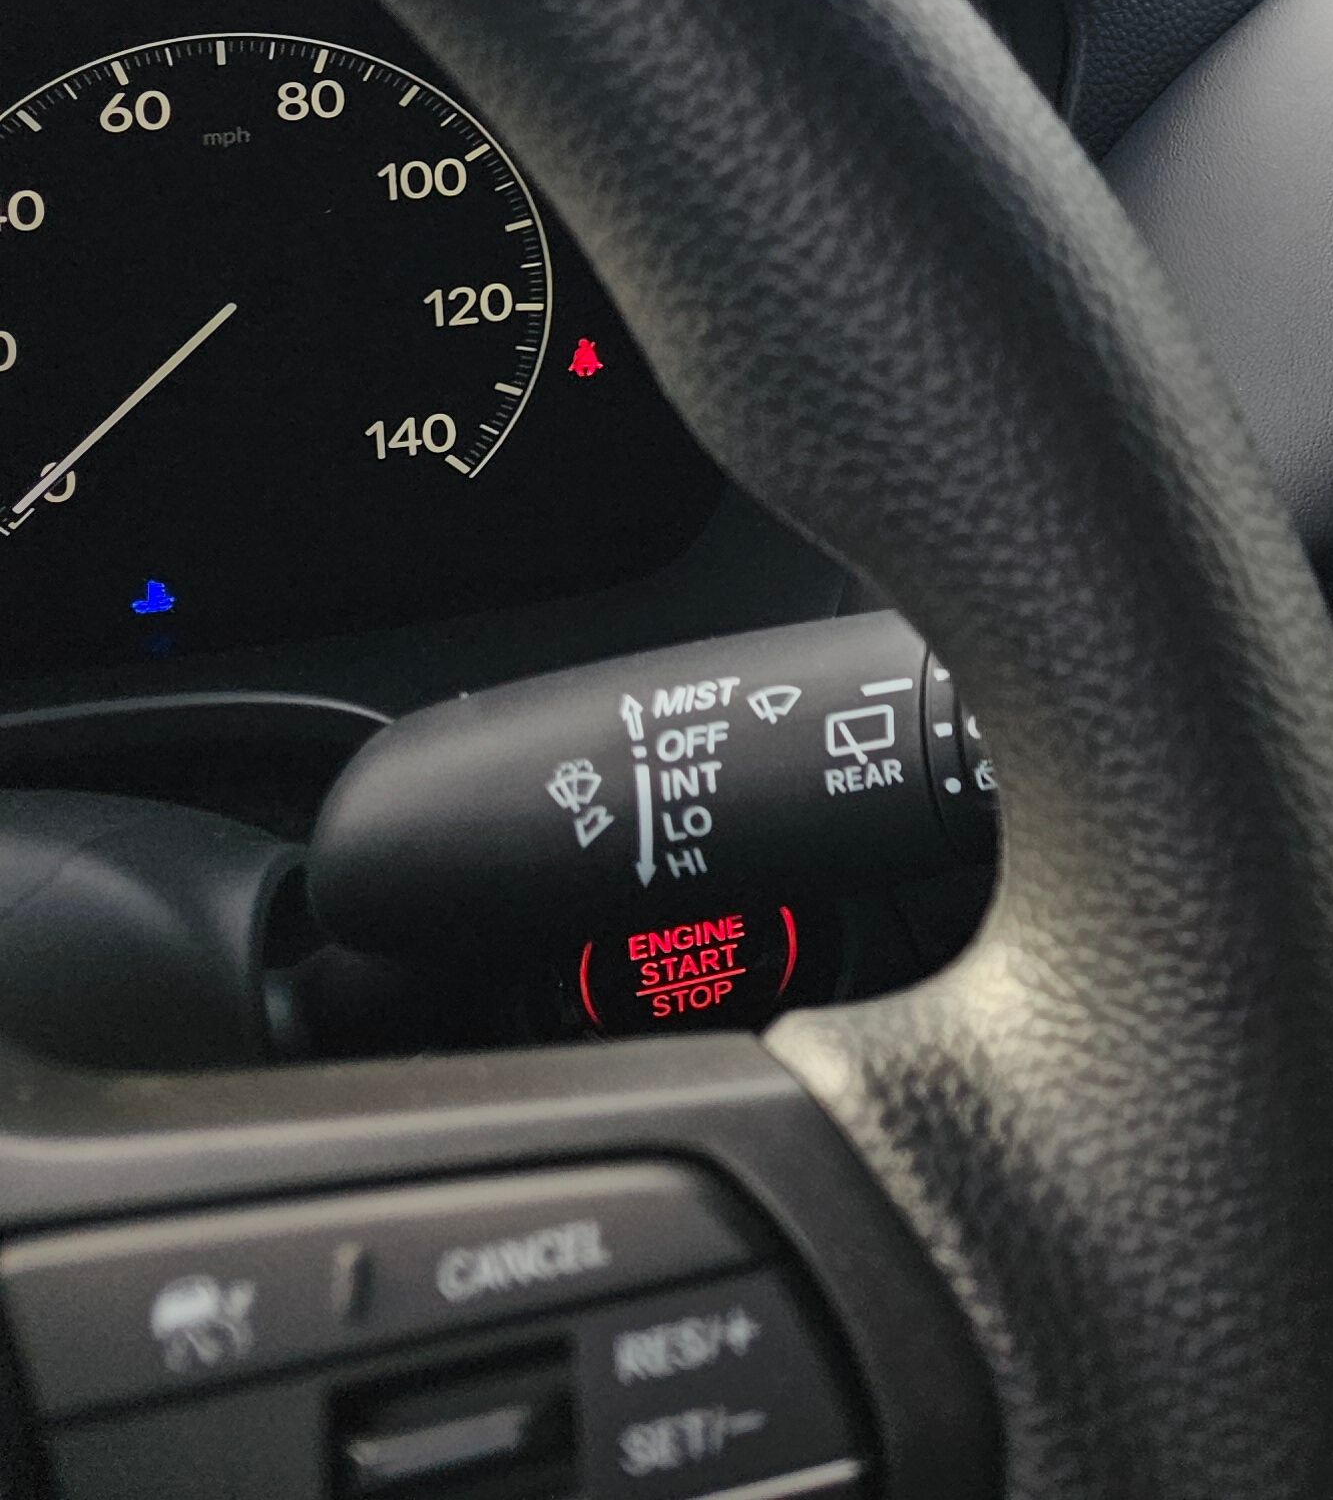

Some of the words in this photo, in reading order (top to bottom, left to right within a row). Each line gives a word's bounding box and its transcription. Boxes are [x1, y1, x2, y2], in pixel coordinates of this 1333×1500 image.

[100, 90, 172, 133] 60
[276, 79, 346, 122] 80
[202, 126, 251, 148] mph
[376, 158, 468, 201] 100
[0, 189, 45, 231] 0
[423, 283, 515, 328] 120
[364, 413, 457, 460] 140
[653, 676, 741, 719] MIST
[656, 721, 730, 762] OFF
[660, 761, 723, 801] INT
[825, 758, 904, 796] REAR
[662, 805, 713, 842] LO
[665, 847, 708, 878] HI
[628, 914, 746, 961] ENGINE
[640, 944, 738, 987] START
[653, 980, 733, 1017] STOP
[436, 1219, 612, 1302] CANCEL
